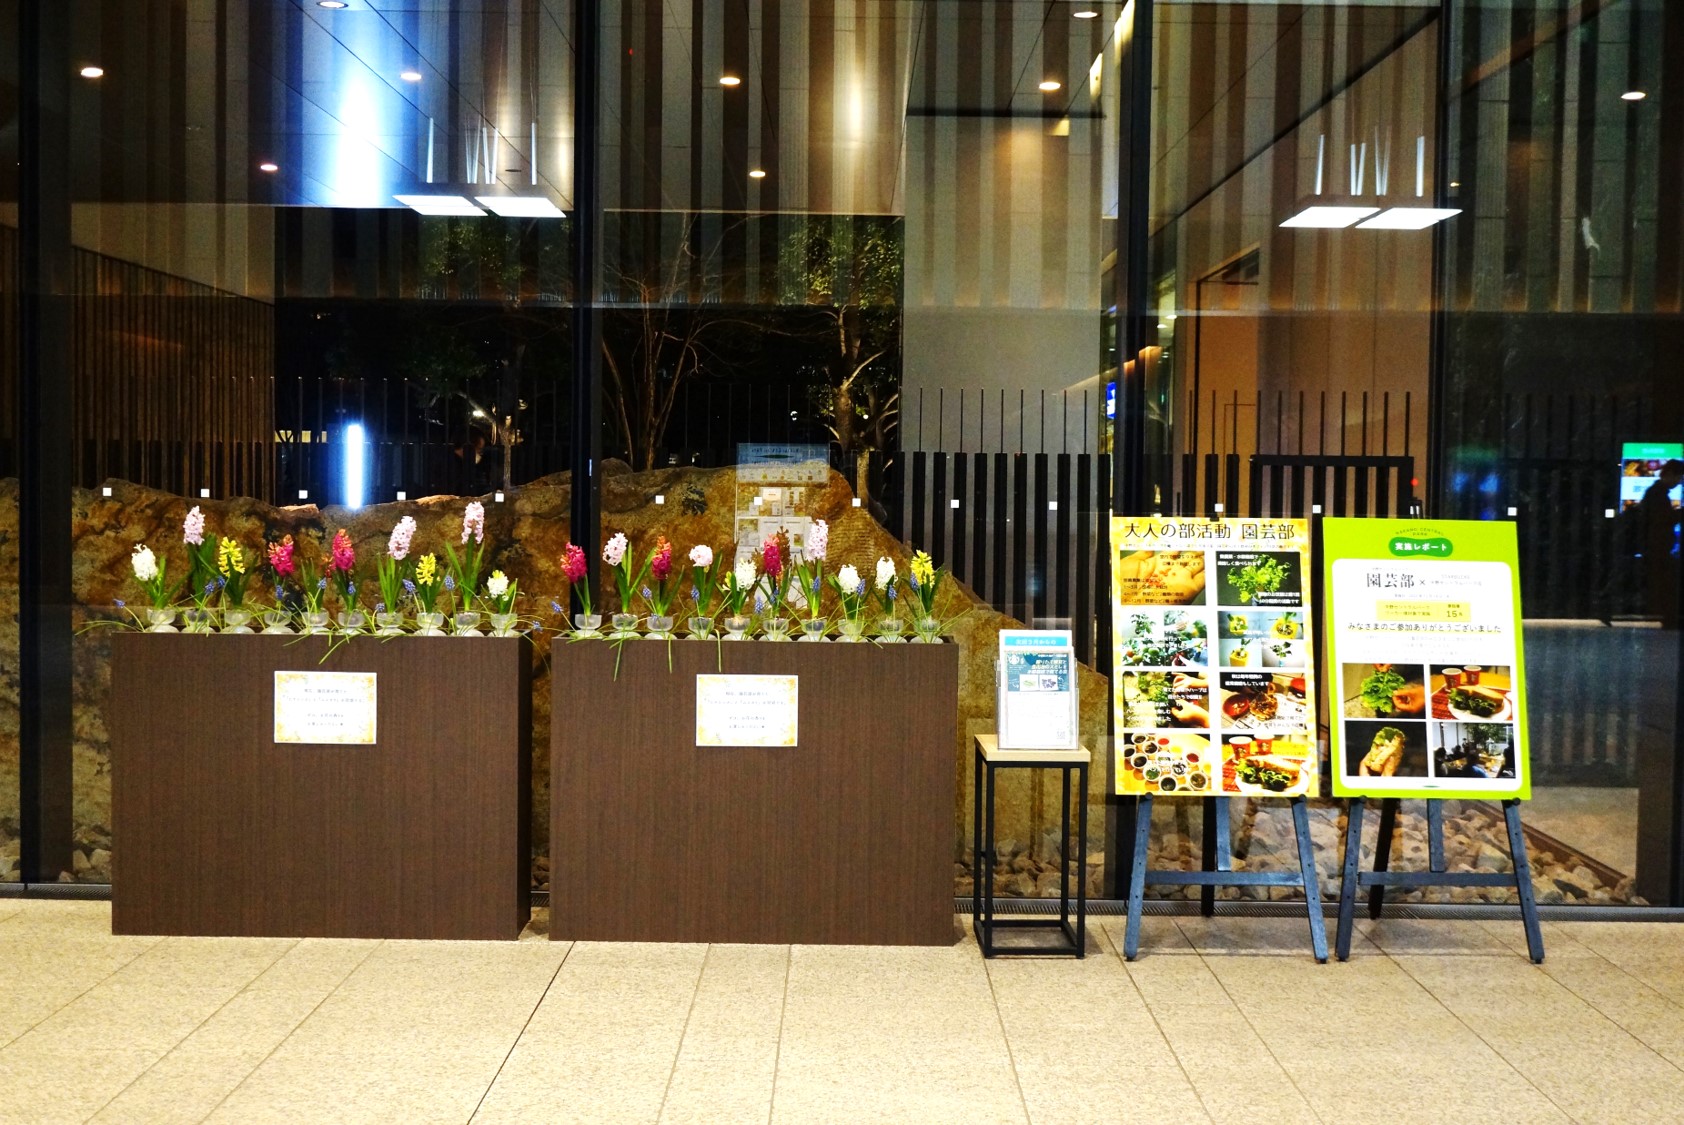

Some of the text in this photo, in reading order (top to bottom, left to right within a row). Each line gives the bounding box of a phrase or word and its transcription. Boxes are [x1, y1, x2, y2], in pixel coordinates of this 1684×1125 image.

[1124, 523, 1295, 540] 大人の部活動 園芸部
[1394, 542, 1447, 552] 実施レポート
[1366, 572, 1415, 588] 園芸部
[1347, 622, 1502, 633] みなさまのご参加ありがとうございました
